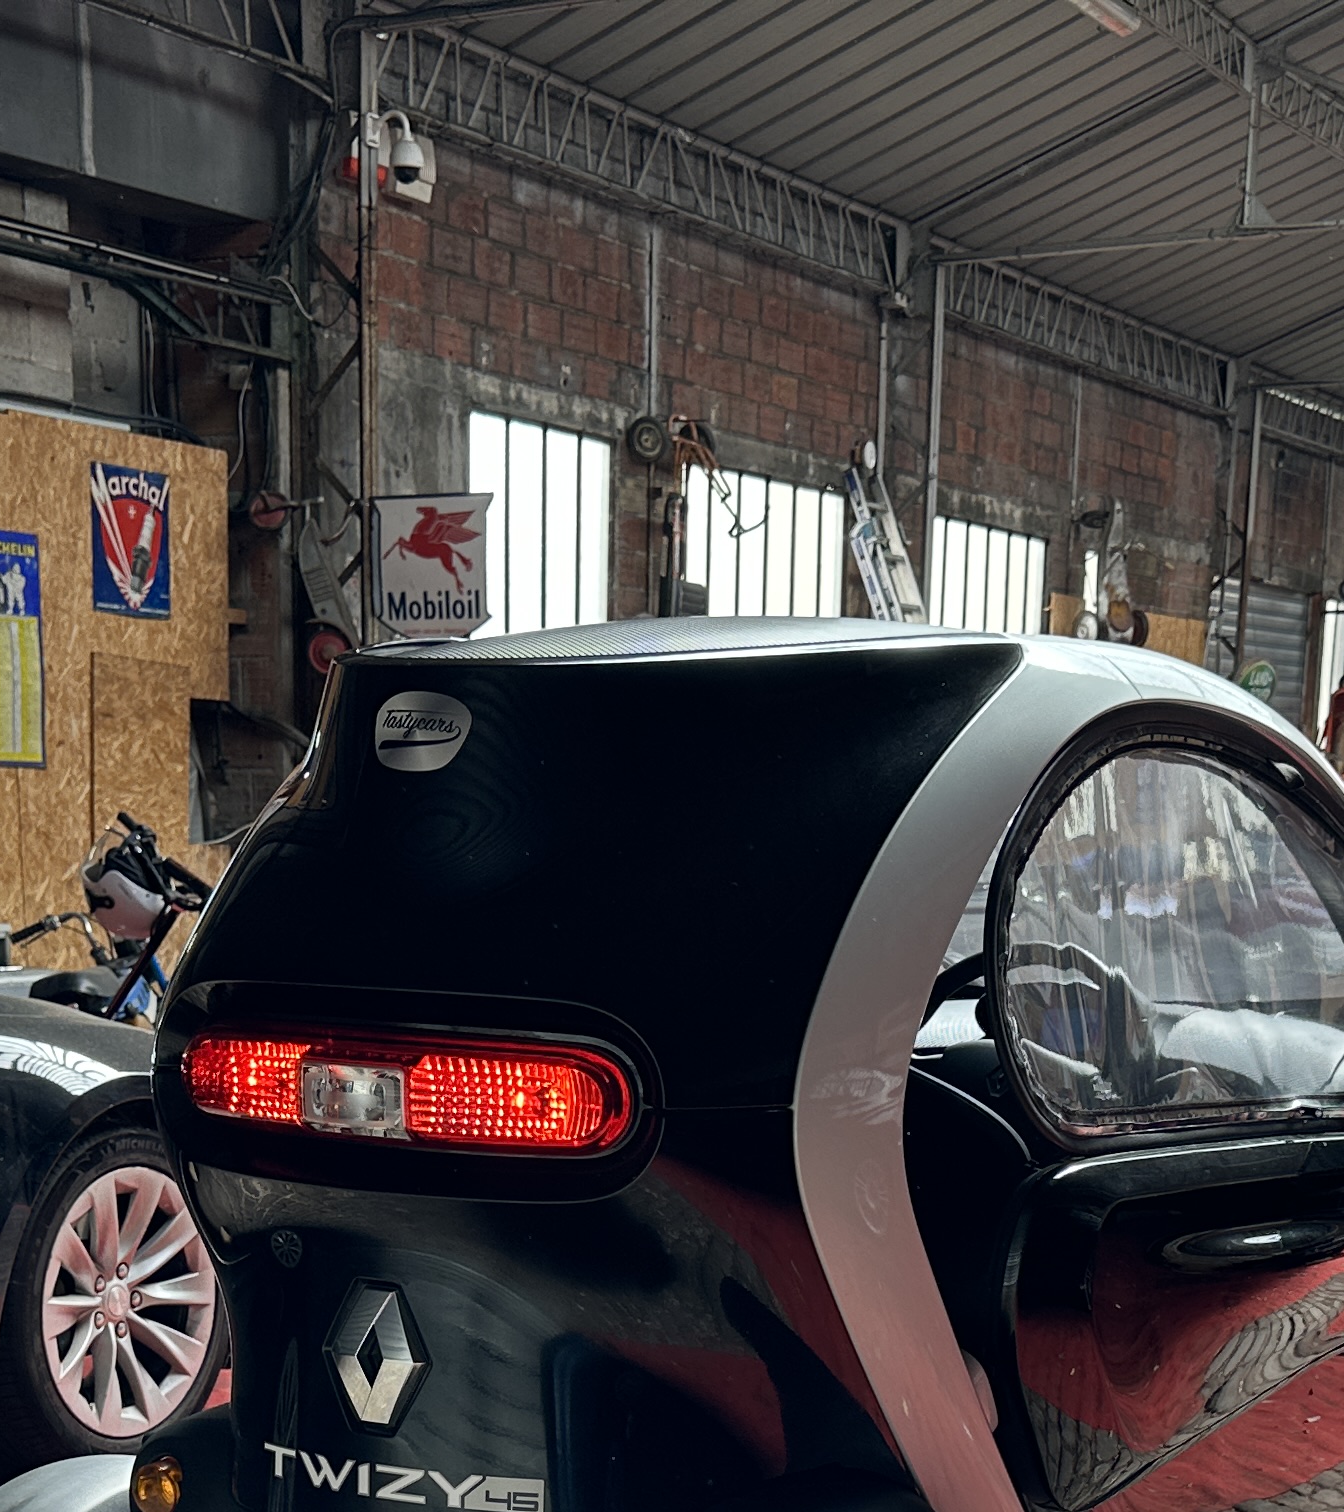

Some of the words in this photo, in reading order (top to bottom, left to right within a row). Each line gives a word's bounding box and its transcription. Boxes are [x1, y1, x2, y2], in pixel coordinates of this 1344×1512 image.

[91, 461, 170, 512] Marchal
[387, 589, 480, 621] Mobiloil
[382, 709, 456, 739] Tastycars
[264, 1441, 483, 1508] TWIZY
[485, 1490, 539, 1512] 45
